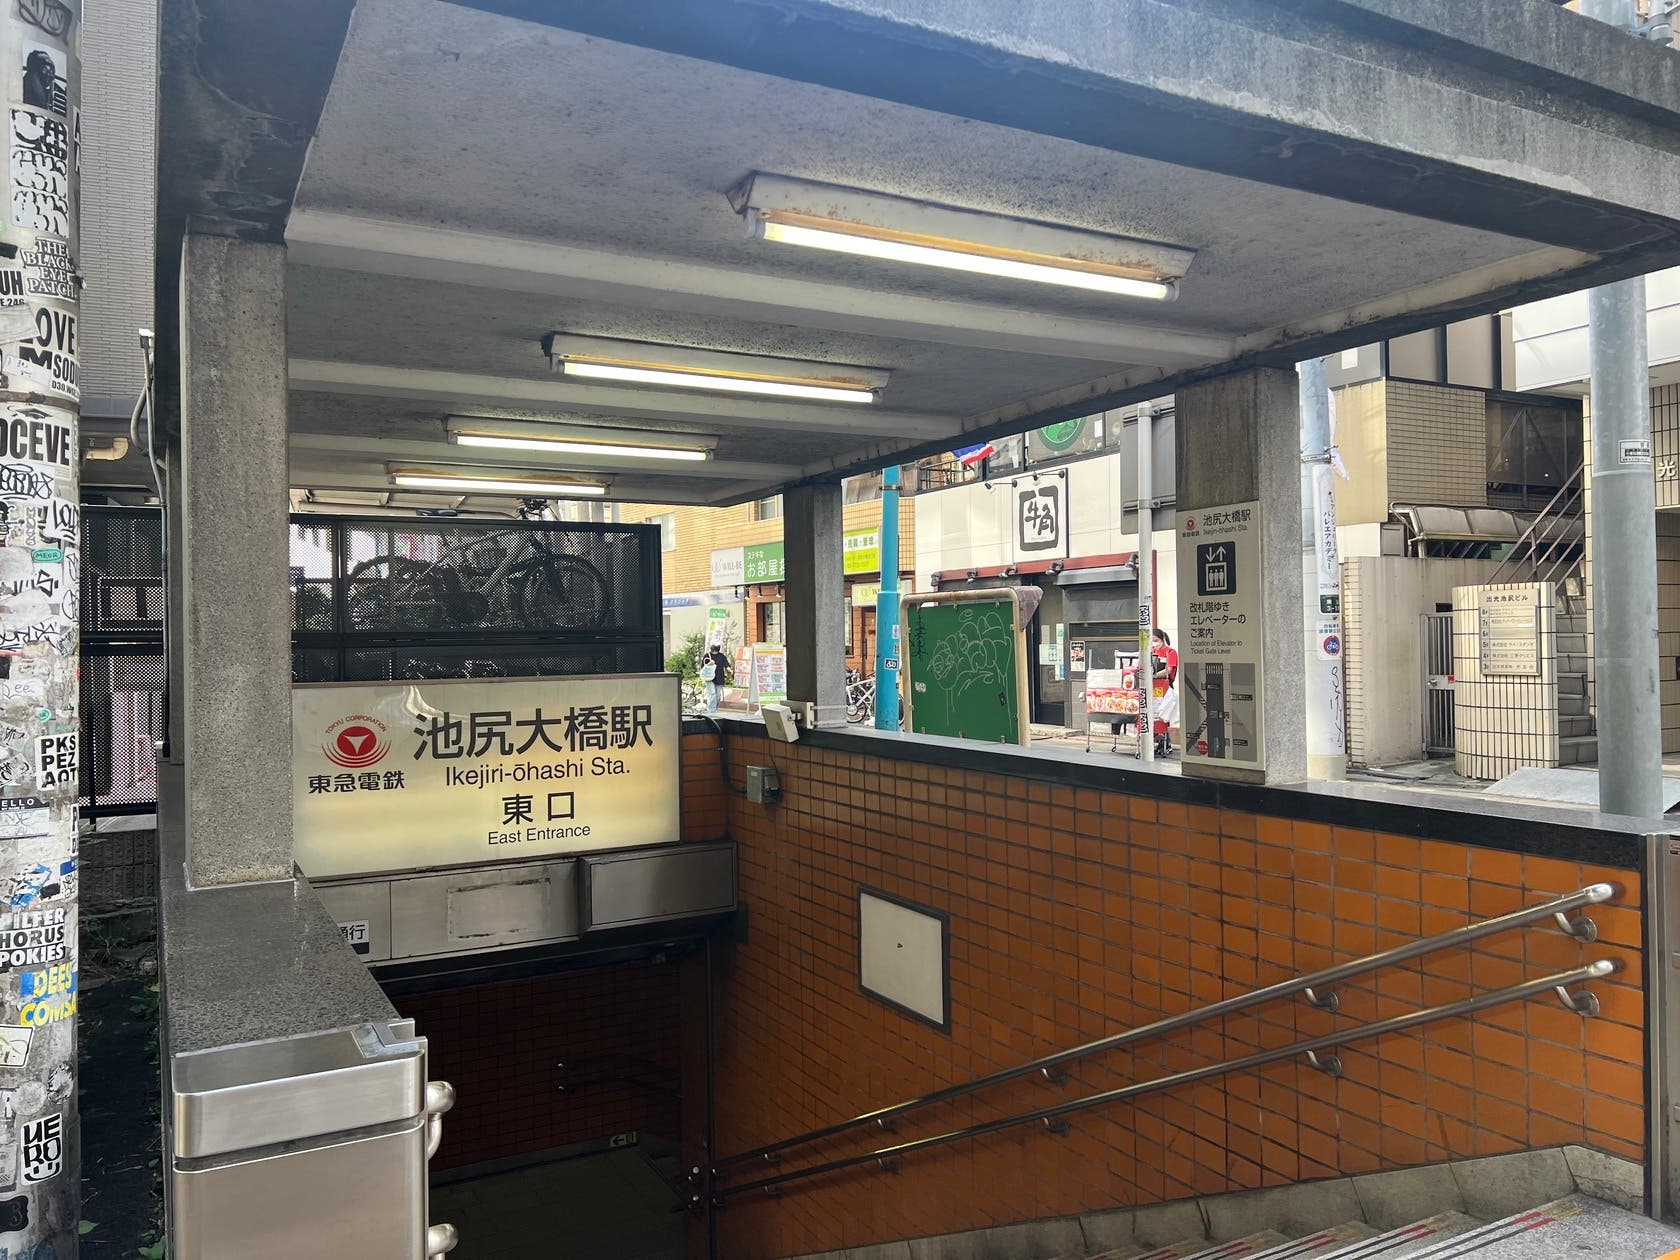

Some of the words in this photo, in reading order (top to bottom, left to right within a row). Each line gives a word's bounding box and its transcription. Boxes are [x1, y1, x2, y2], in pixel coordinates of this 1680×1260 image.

[35, 239, 67, 257] THE
[24, 252, 74, 272] BLACK
[40, 267, 67, 283] EYE
[28, 279, 75, 298] PATCH
[20, 307, 75, 355] OVE
[1024, 500, 1055, 536] 牛角
[1203, 508, 1251, 527] 池尻大橋駅
[1190, 602, 1230, 613] 改札階ゆき
[1190, 614, 1246, 625] エレベーターの
[1190, 627, 1213, 639] ご案内
[325, 719, 344, 734] TOKYU
[345, 714, 387, 733] CORPORATION
[413, 704, 654, 761] 池尻大橋駅
[40, 735, 76, 754] PKS
[41, 752, 76, 771] PEZ
[591, 757, 630, 776] Sta.
[308, 770, 405, 794] 東急電鉄
[488, 830, 521, 845] East
[526, 824, 591, 842] Entrance
